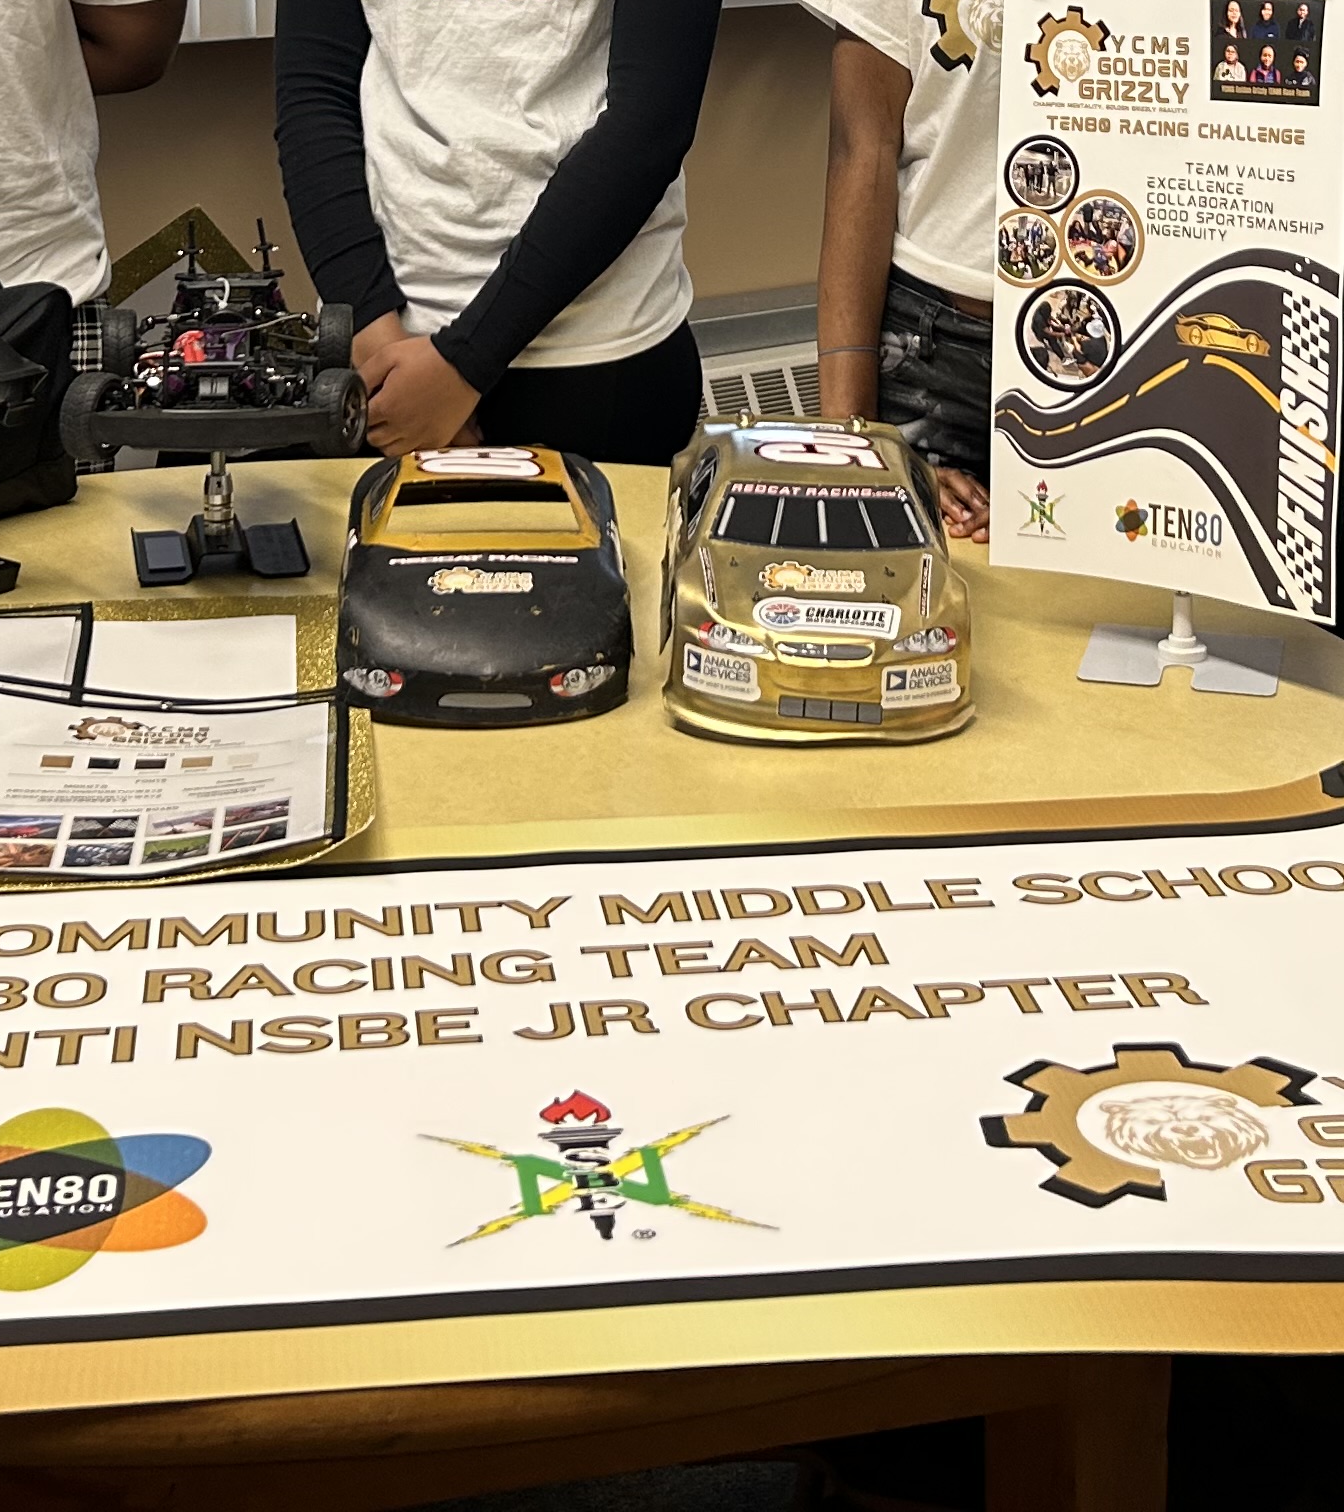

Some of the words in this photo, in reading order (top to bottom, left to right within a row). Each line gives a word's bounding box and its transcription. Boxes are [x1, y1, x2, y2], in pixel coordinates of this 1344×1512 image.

[1098, 57, 1188, 78] GOLDEN
[1078, 78, 1190, 104] GRIZZLY
[1047, 114, 1111, 134] TEN80
[1119, 119, 1190, 138] RACING
[1198, 122, 1306, 145] CHALLENGE
[1185, 162, 1229, 177] TEAM
[1237, 165, 1296, 182] VALUES
[1146, 176, 1244, 195] EXCELLENCE
[1146, 192, 1274, 214] COLLABORATION
[1146, 208, 1190, 224] GOOD
[1196, 211, 1324, 235] SPORTSMANSHIP
[1146, 223, 1227, 241] INGENUITY
[1277, 345, 1329, 544] FINISH
[731, 483, 801, 496] REDCAT
[1148, 503, 1223, 547] TEN80
[1151, 537, 1222, 559] EDUCATION
[805, 606, 887, 622] CHARLOTTE
[703, 654, 751, 672] ANALOG
[910, 663, 952, 680] ANALOG
[703, 665, 751, 684] DEVICES
[909, 673, 952, 690] DEVICES
[601, 877, 996, 928] MIDDLE
[142, 948, 556, 1004] RACING
[581, 931, 891, 979] TEAM
[175, 1006, 483, 1063] NSBE
[513, 998, 661, 1042] JR
[685, 971, 1210, 1032] CHAPTER
